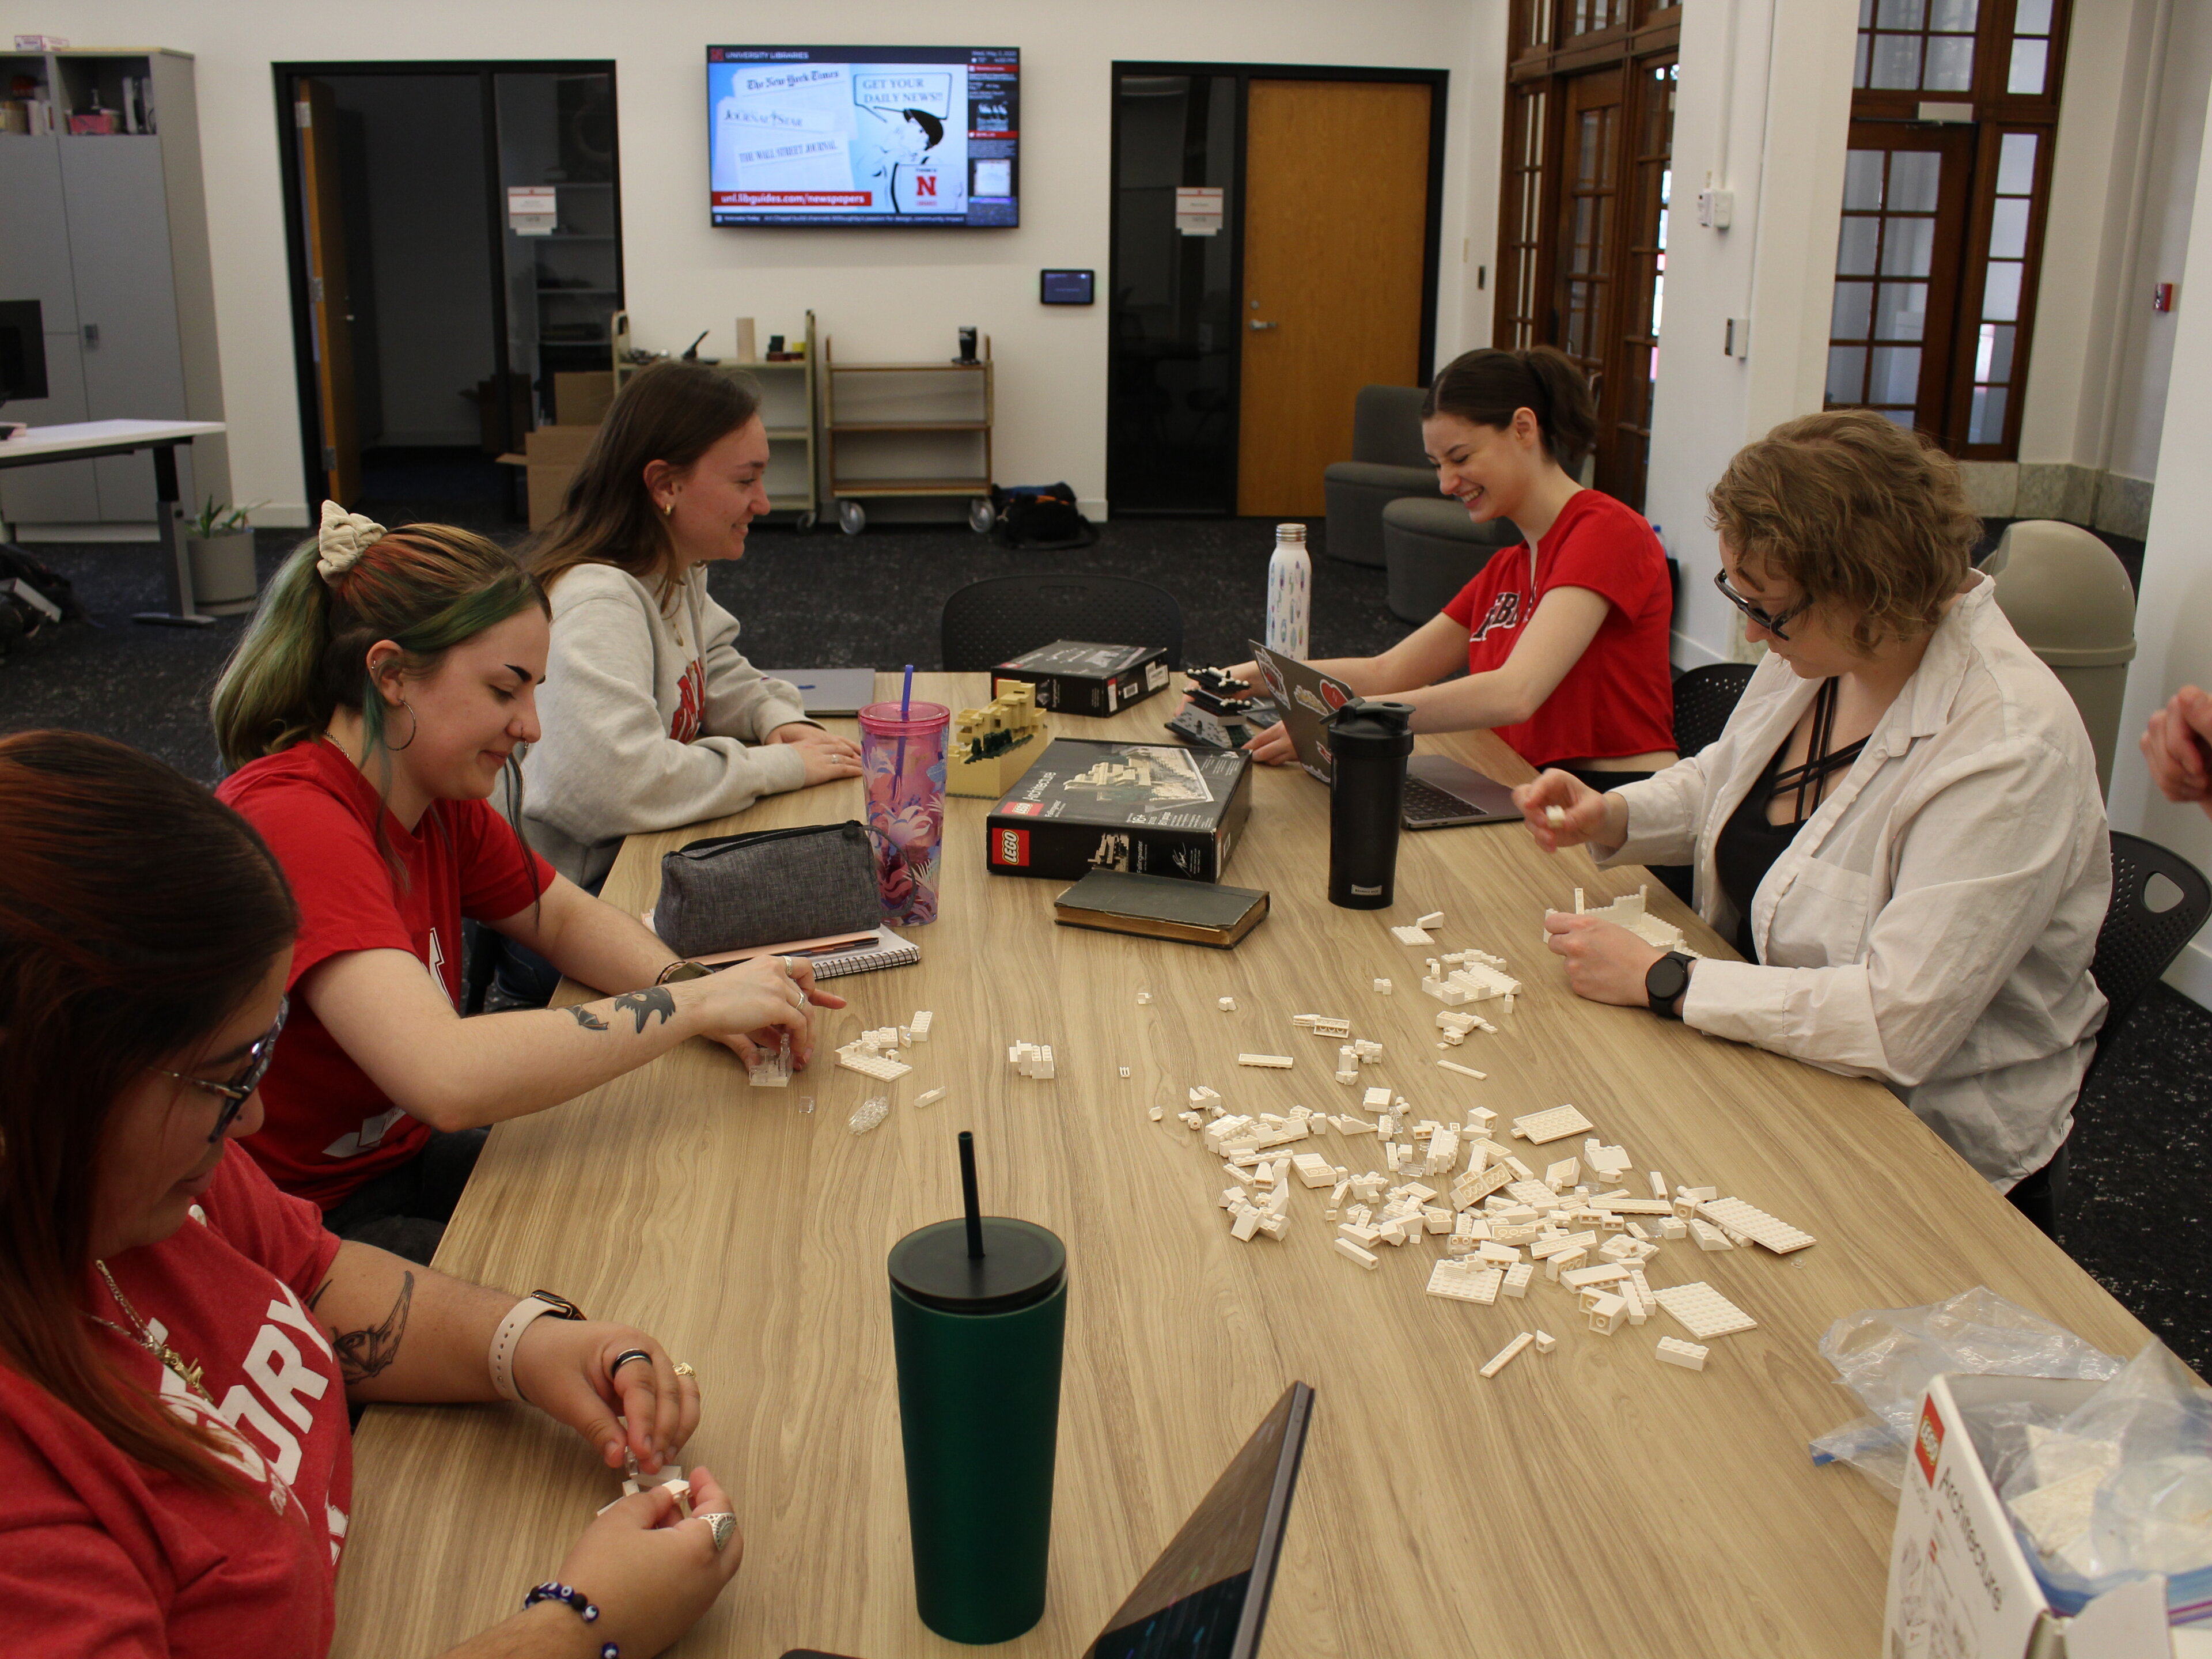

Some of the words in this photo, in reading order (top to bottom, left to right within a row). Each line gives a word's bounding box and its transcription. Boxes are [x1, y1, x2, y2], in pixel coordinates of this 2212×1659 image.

[747, 79, 763, 90] The
[766, 77, 785, 88] New
[787, 74, 809, 87] York
[811, 70, 838, 81] Times
[863, 78, 886, 89] GET
[888, 78, 924, 88] YOUR
[863, 93, 899, 104] DAILY
[739, 152, 754, 162] THE
[756, 149, 774, 160] WALL
[777, 144, 803, 157] STREET
[916, 176, 937, 196] N
[721, 194, 864, 205] unl.libguides.com/newspapers
[1022, 772, 1056, 802] Architecture
[1012, 802, 1033, 815] LEGO
[1131, 814, 1147, 824] 16+
[1002, 830, 1019, 865] LEGO
[1937, 1467, 2003, 1612] Architecture
